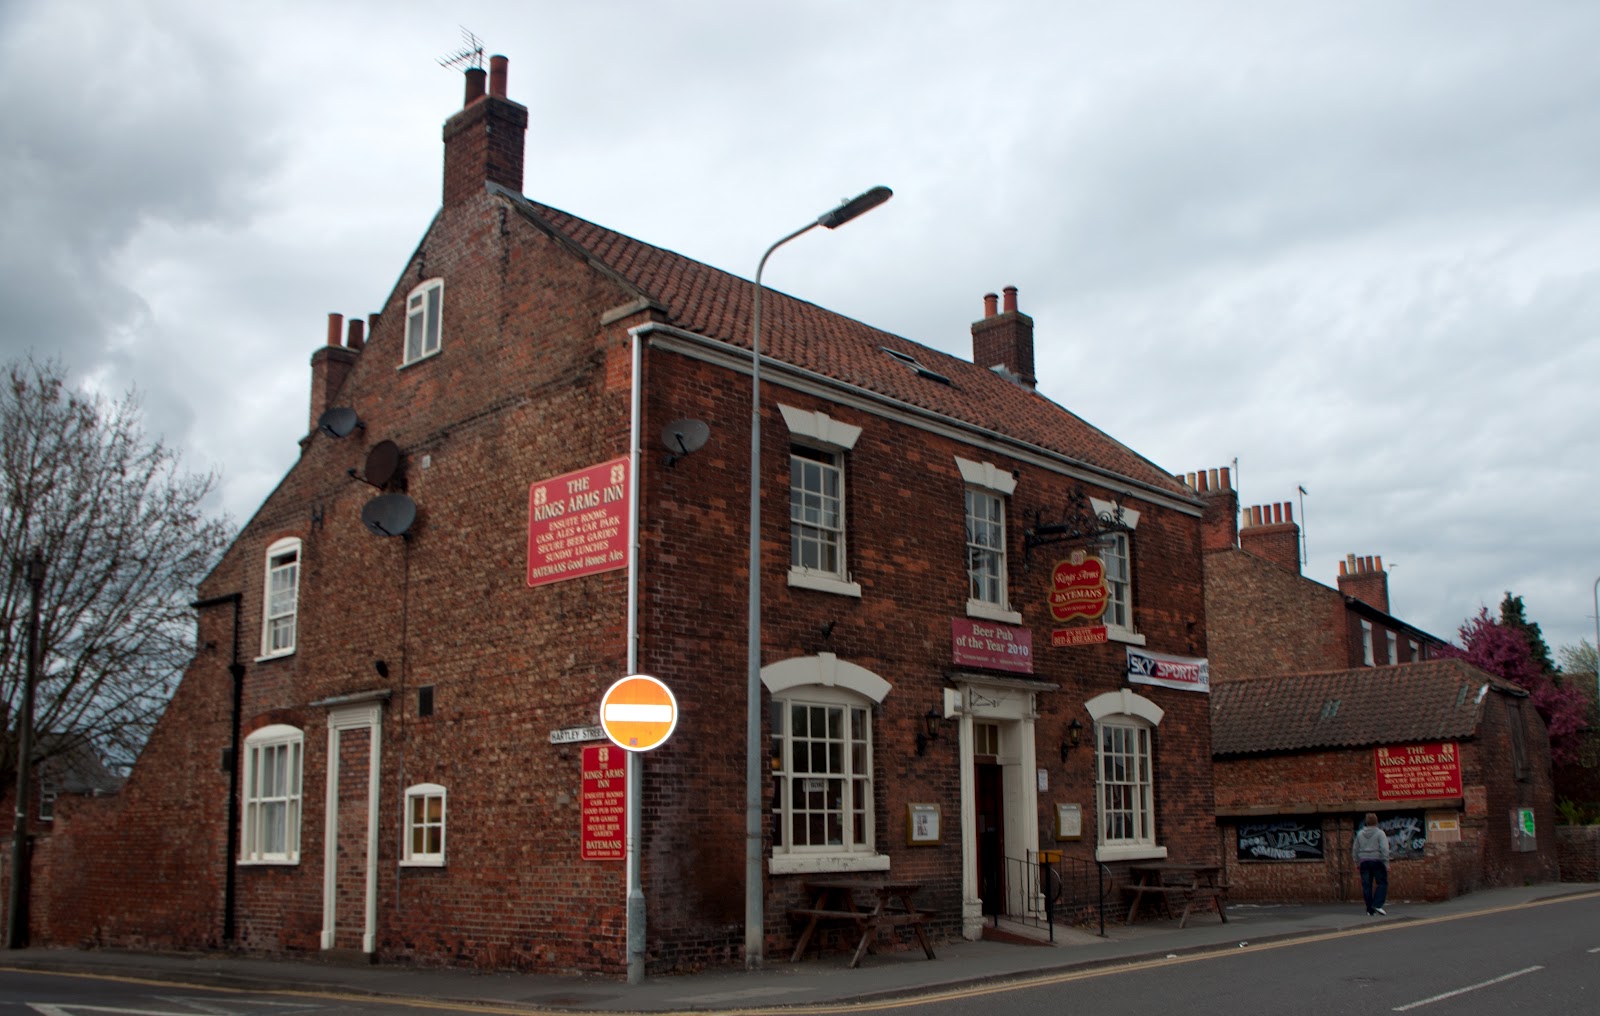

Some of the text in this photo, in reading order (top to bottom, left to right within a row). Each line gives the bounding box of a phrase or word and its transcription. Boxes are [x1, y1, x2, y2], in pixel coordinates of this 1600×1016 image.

[566, 476, 590, 494] THE
[534, 484, 624, 521] KINGS ARMS INN
[549, 509, 607, 531] ENSUITE ROOMS
[536, 516, 620, 544] CASK ALES CAR PARK
[538, 528, 618, 554] SECURE BEER GARDEN
[545, 540, 609, 563] SUNDAY LUNCHES
[532, 562, 566, 578] BATEMANS
[1056, 590, 1102, 602] BATEMANS
[972, 624, 1013, 641] Beer Pub
[1072, 633, 1104, 643] BREAKFAST
[956, 635, 1029, 656] of the Year 2010
[1130, 656, 1198, 680] SKY SPORTS
[552, 729, 604, 741] HARTLEY STREE
[1406, 746, 1425, 754] THE
[1380, 754, 1454, 766] KINGS ARMS INN
[584, 769, 624, 780] KINGS ARMS
[598, 780, 609, 788] INN
[586, 840, 621, 850] BATEMANS
[1277, 829, 1321, 848] DARTS
[1250, 845, 1296, 859] DOMINOES
